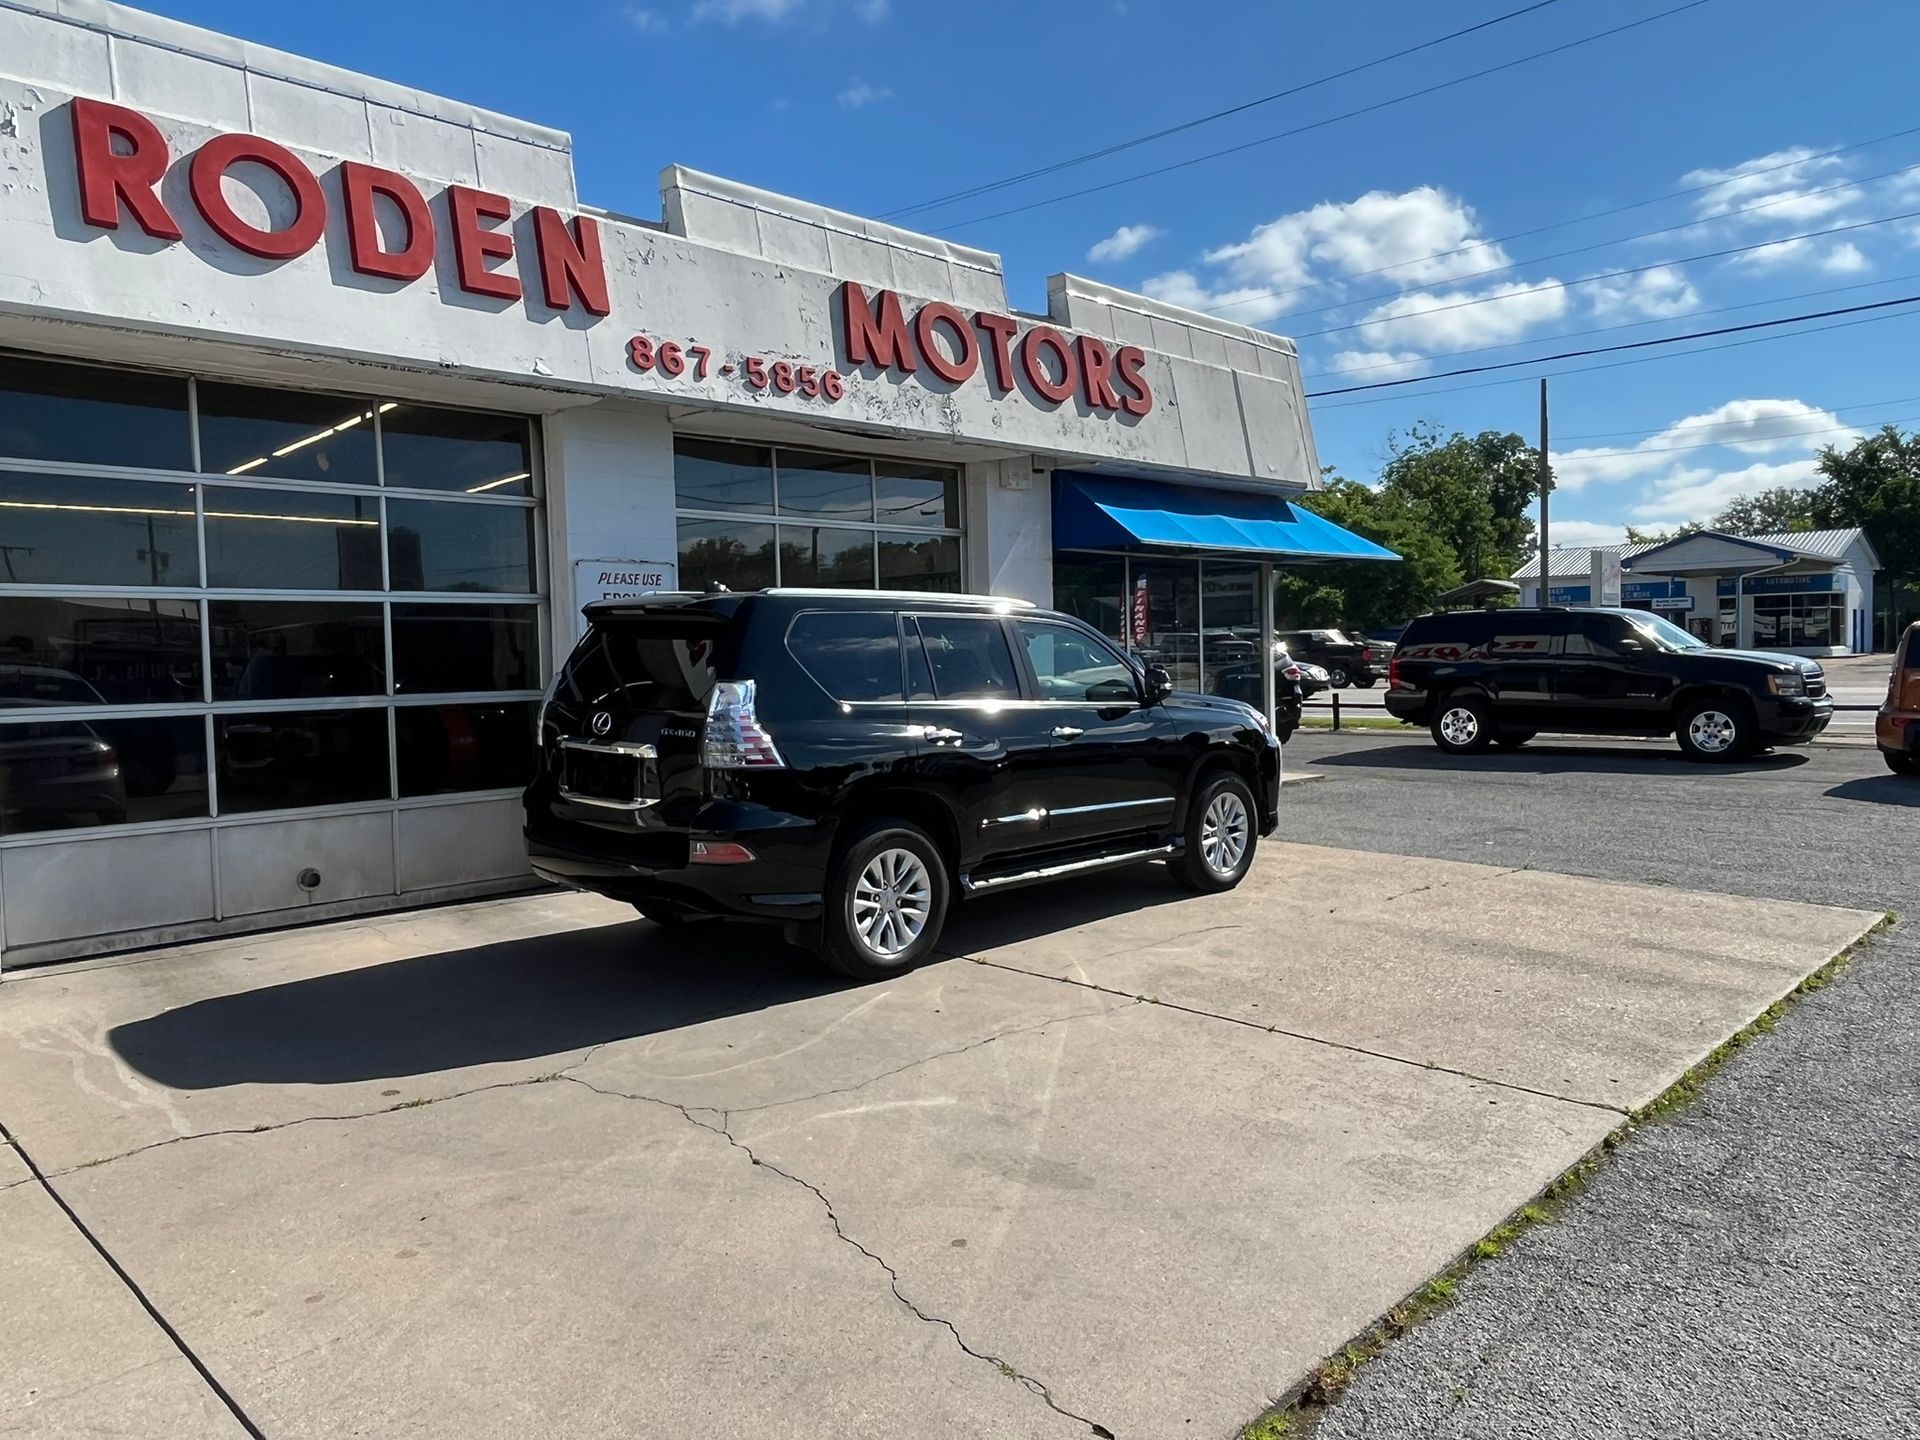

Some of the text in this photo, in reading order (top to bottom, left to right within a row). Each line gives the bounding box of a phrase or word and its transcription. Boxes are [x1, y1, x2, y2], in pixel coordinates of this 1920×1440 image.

[71, 97, 1153, 417] RODEN MOTORS
[598, 572, 663, 586] PLEASE USE
